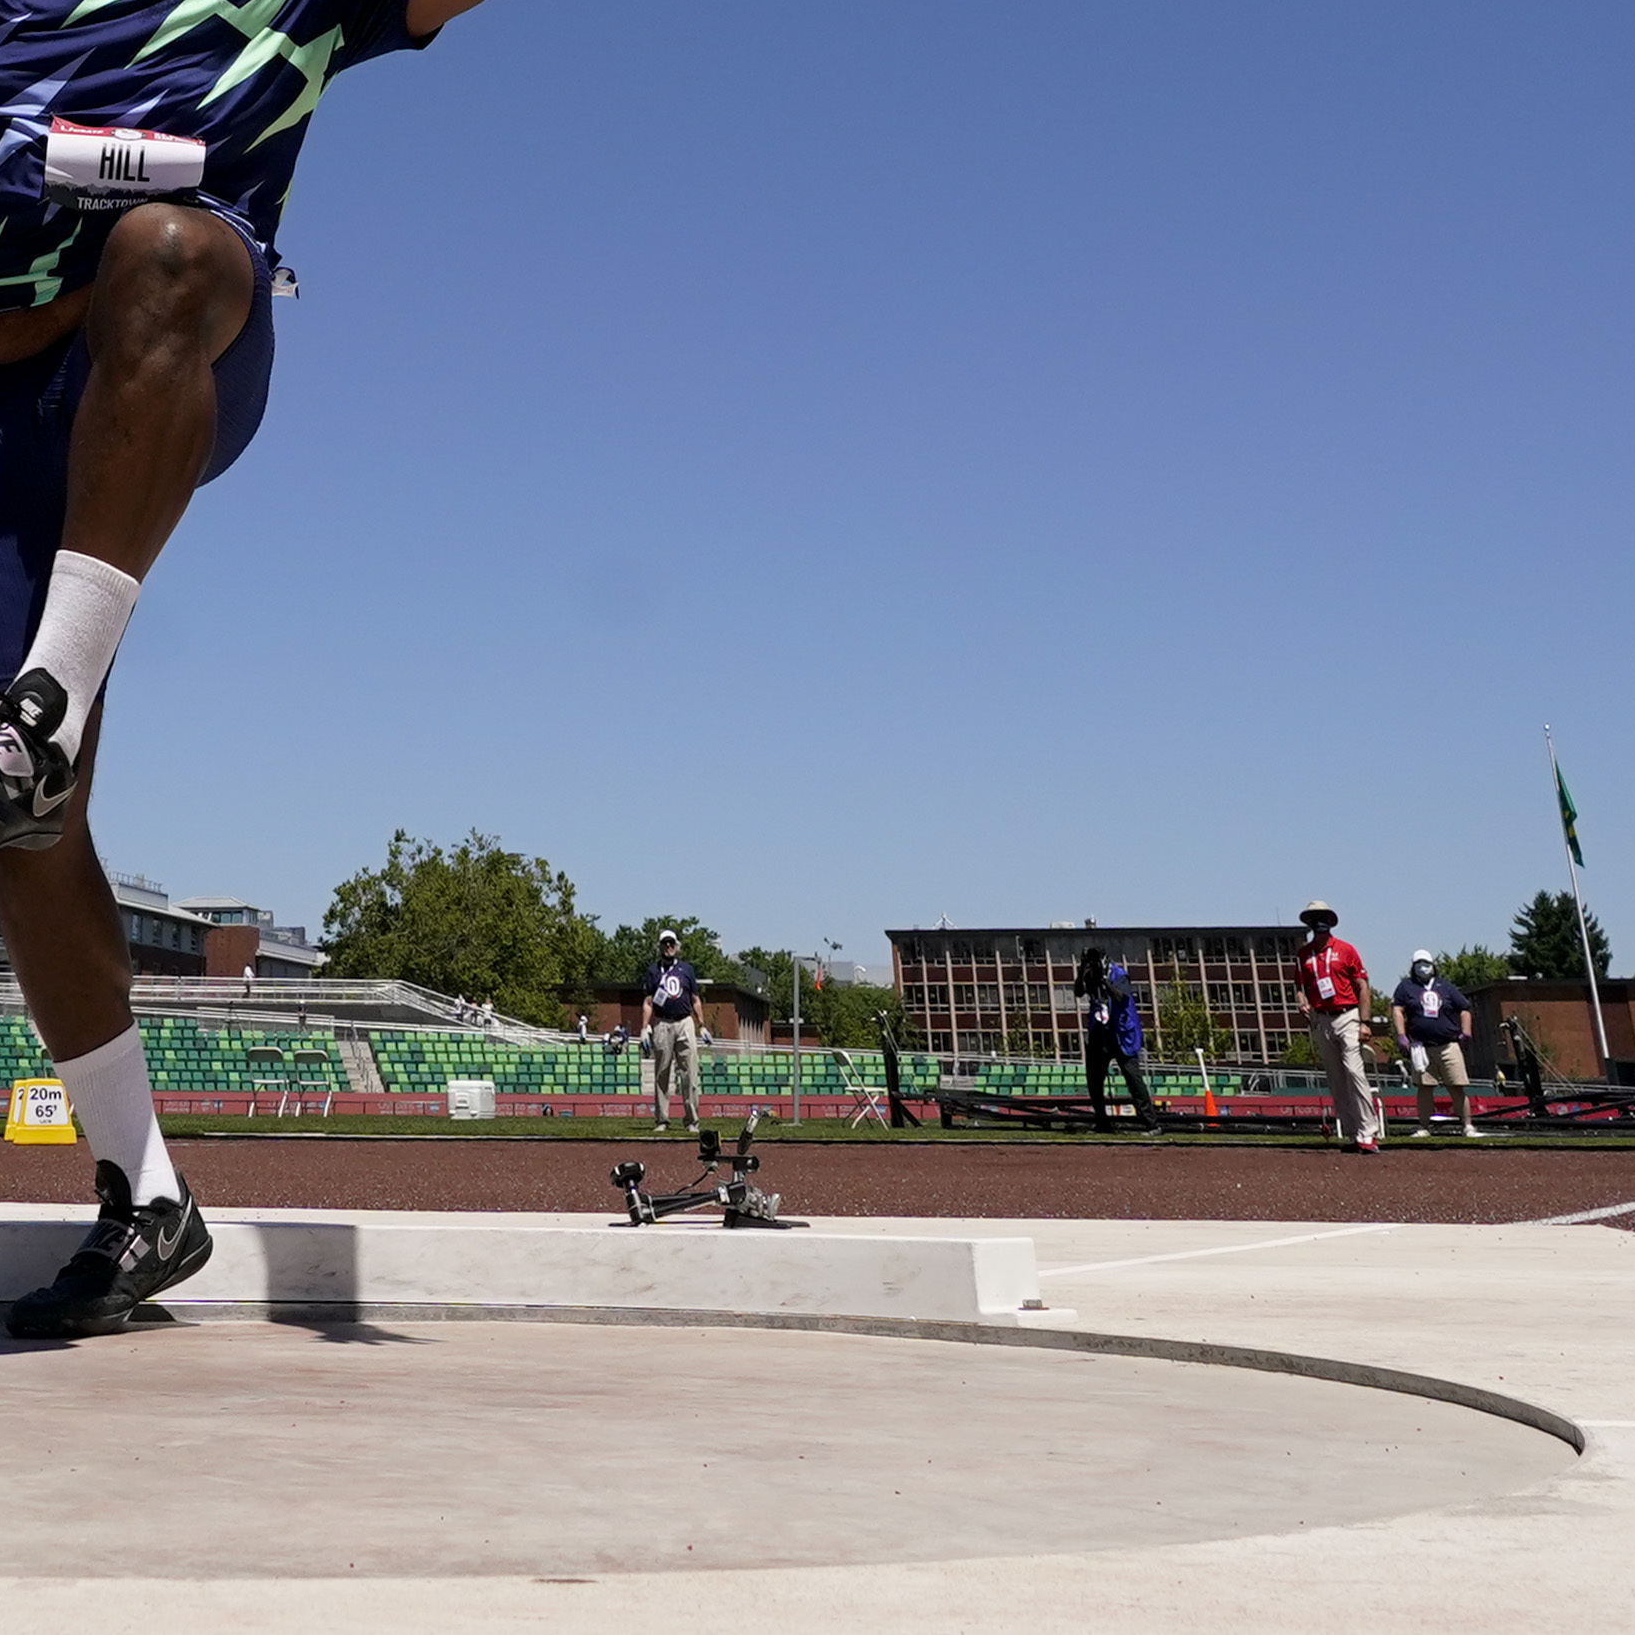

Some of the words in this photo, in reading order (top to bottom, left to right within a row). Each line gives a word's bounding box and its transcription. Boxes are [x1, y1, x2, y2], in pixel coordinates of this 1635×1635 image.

[99, 143, 150, 182] HILL
[19, 698, 43, 717] NIKE
[18, 1088, 25, 1100] 2
[30, 1088, 62, 1100] 20m
[35, 1104, 57, 1118] 65'
